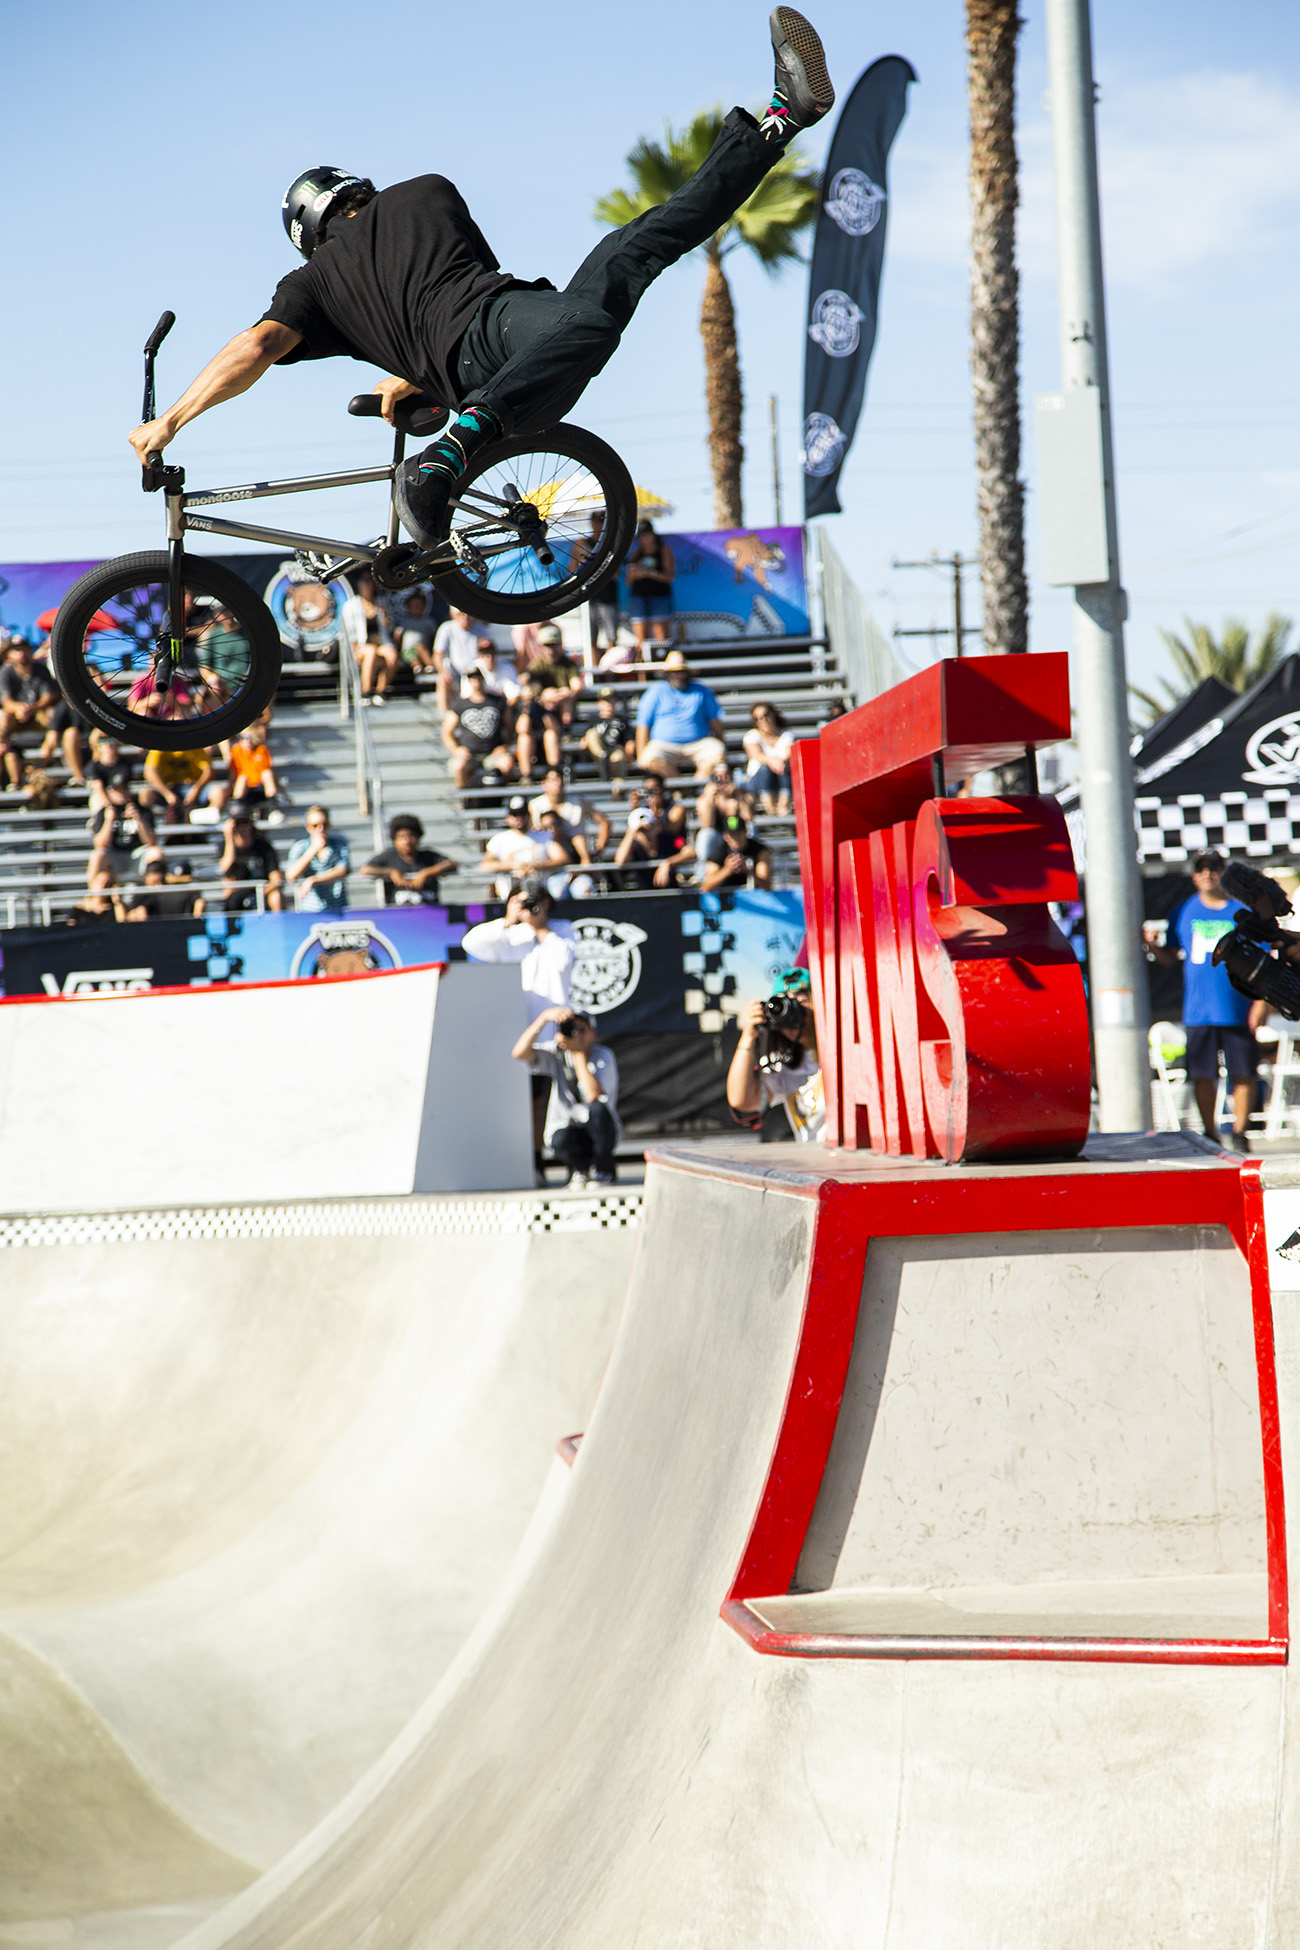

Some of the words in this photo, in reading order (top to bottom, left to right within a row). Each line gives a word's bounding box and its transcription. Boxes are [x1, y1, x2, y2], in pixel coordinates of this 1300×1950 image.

[187, 490, 254, 507] mongoose
[186, 515, 213, 531] VANS
[791, 657, 967, 1166] VANS
[574, 946, 629, 980] ANS
